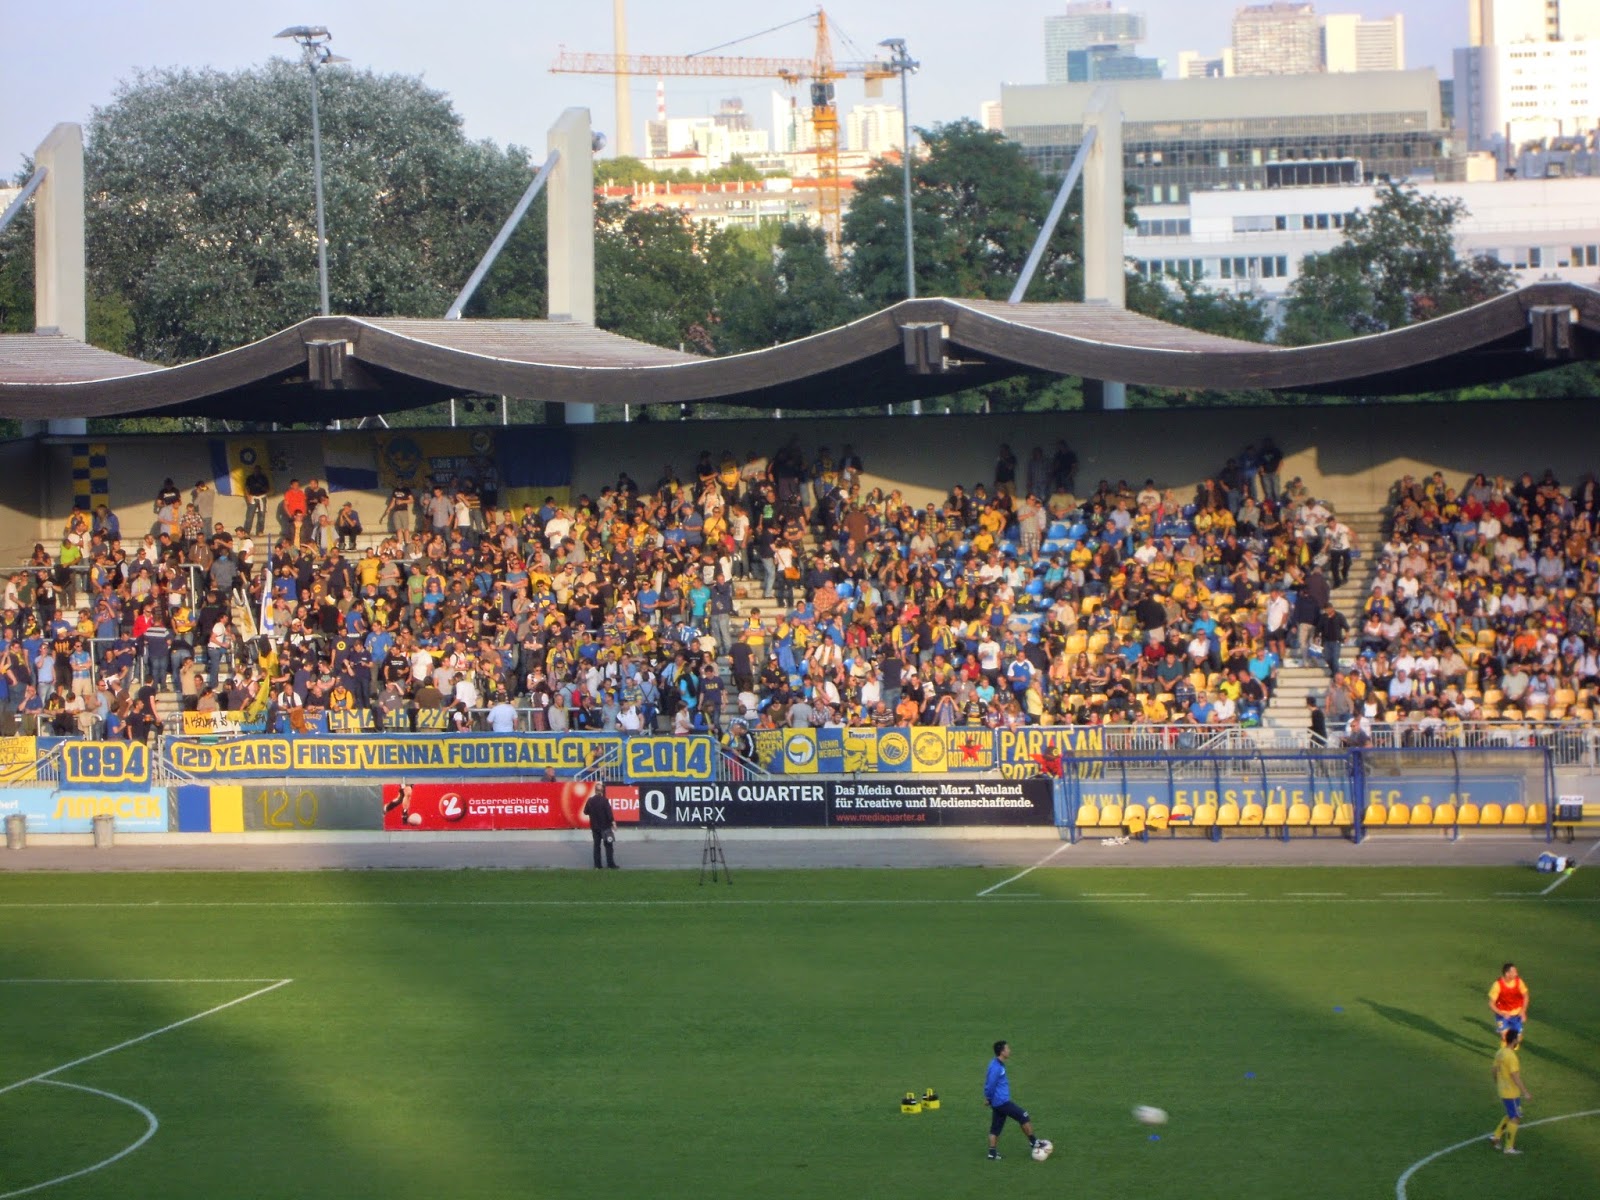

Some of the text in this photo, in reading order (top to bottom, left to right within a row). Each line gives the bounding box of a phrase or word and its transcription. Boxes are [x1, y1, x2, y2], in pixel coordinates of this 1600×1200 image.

[67, 745, 144, 778] 1894
[175, 746, 212, 768] 120
[215, 744, 287, 767] YEARS
[297, 743, 359, 765] FIRST
[363, 743, 444, 765] VIENNA
[448, 742, 559, 764] FOOTBALL
[631, 741, 709, 774] 2014
[675, 786, 825, 802] MEDIA QUARTER
[835, 785, 1023, 796] Das Media Quarter Marx. Neuland
[52, 795, 162, 820] SIMACEK
[255, 789, 319, 827] 120
[468, 797, 549, 805] österreichische
[644, 789, 668, 820] Q
[835, 797, 1034, 808] für Kreative und Medienschaffende.
[468, 805, 549, 815] LOTTERIEN
[675, 806, 726, 822] MARX
[835, 813, 926, 823] www.mediaquarter.at
